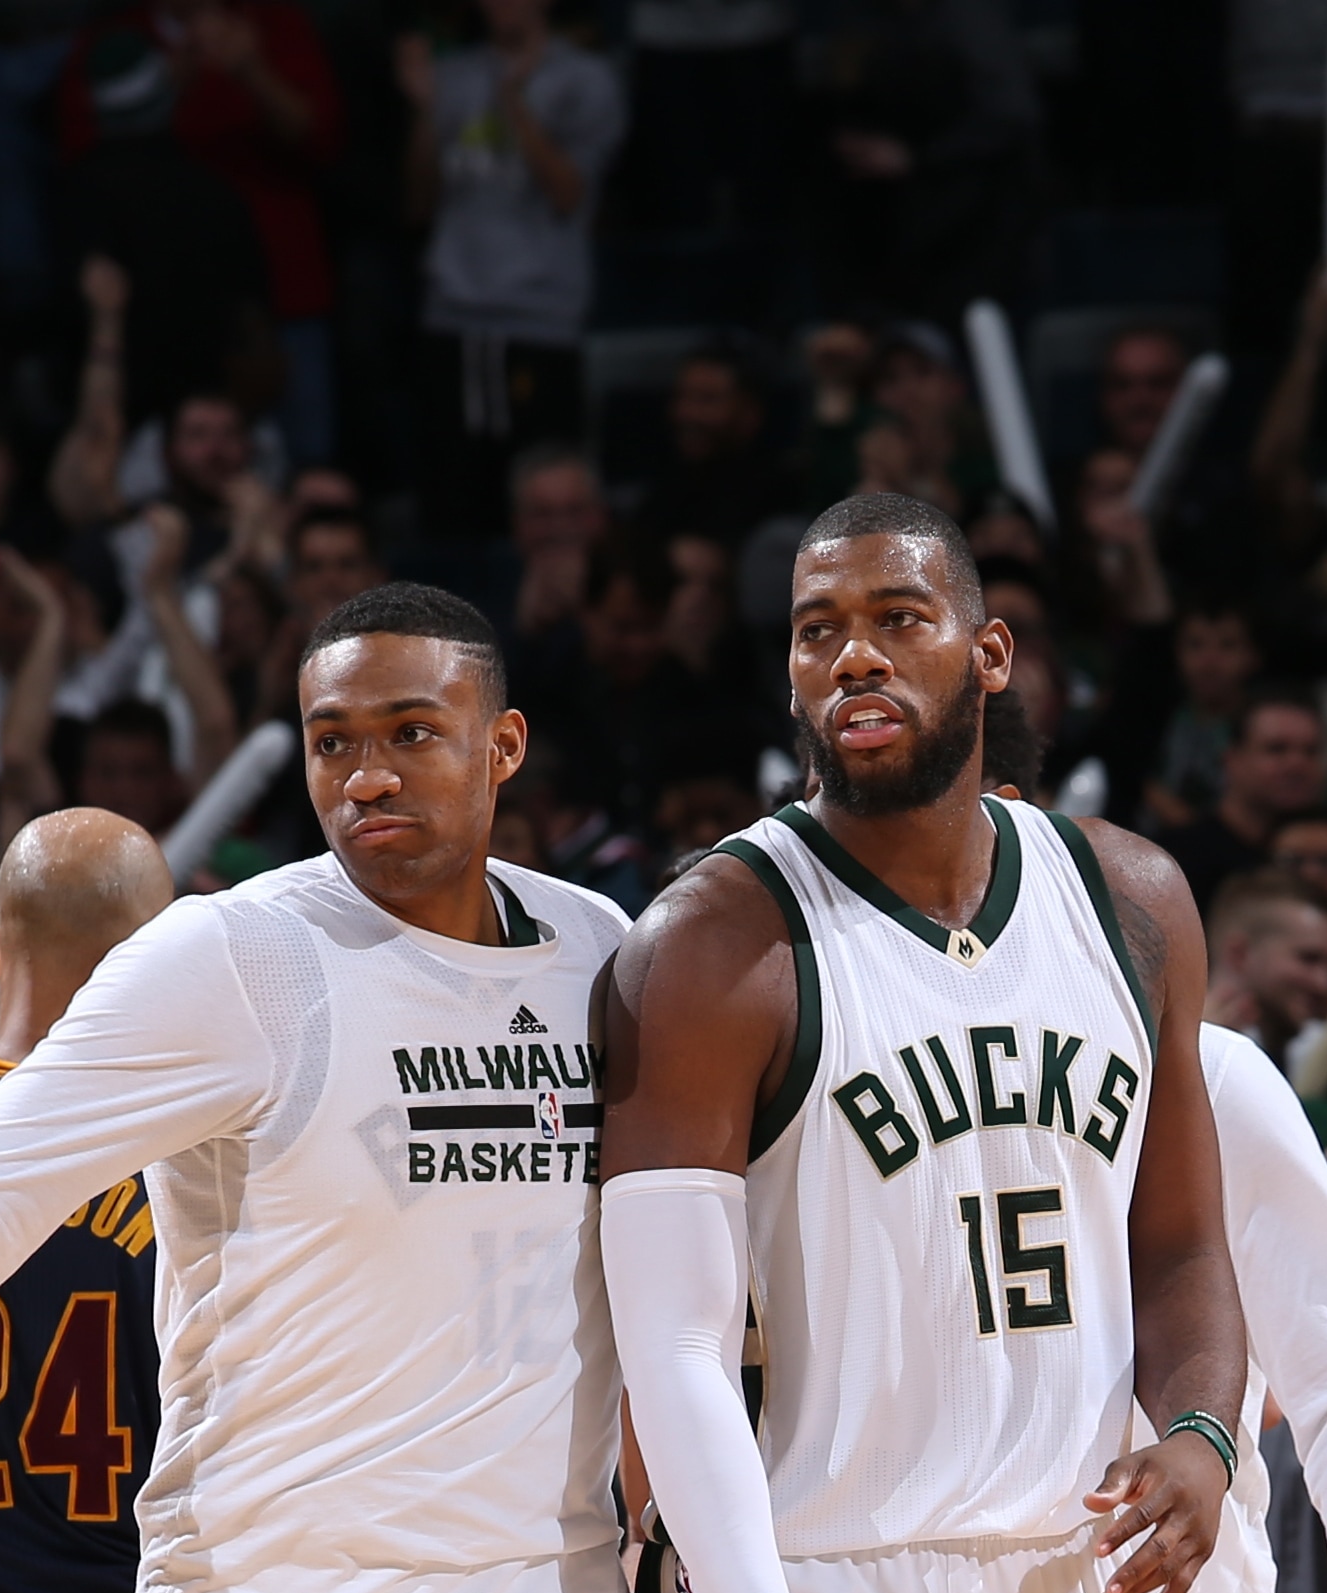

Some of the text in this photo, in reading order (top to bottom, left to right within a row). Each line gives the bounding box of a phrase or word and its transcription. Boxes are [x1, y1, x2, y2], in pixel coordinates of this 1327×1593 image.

[509, 1022, 548, 1034] adidas
[831, 1024, 1140, 1181] BUCKS
[957, 1185, 1075, 1338] 15
